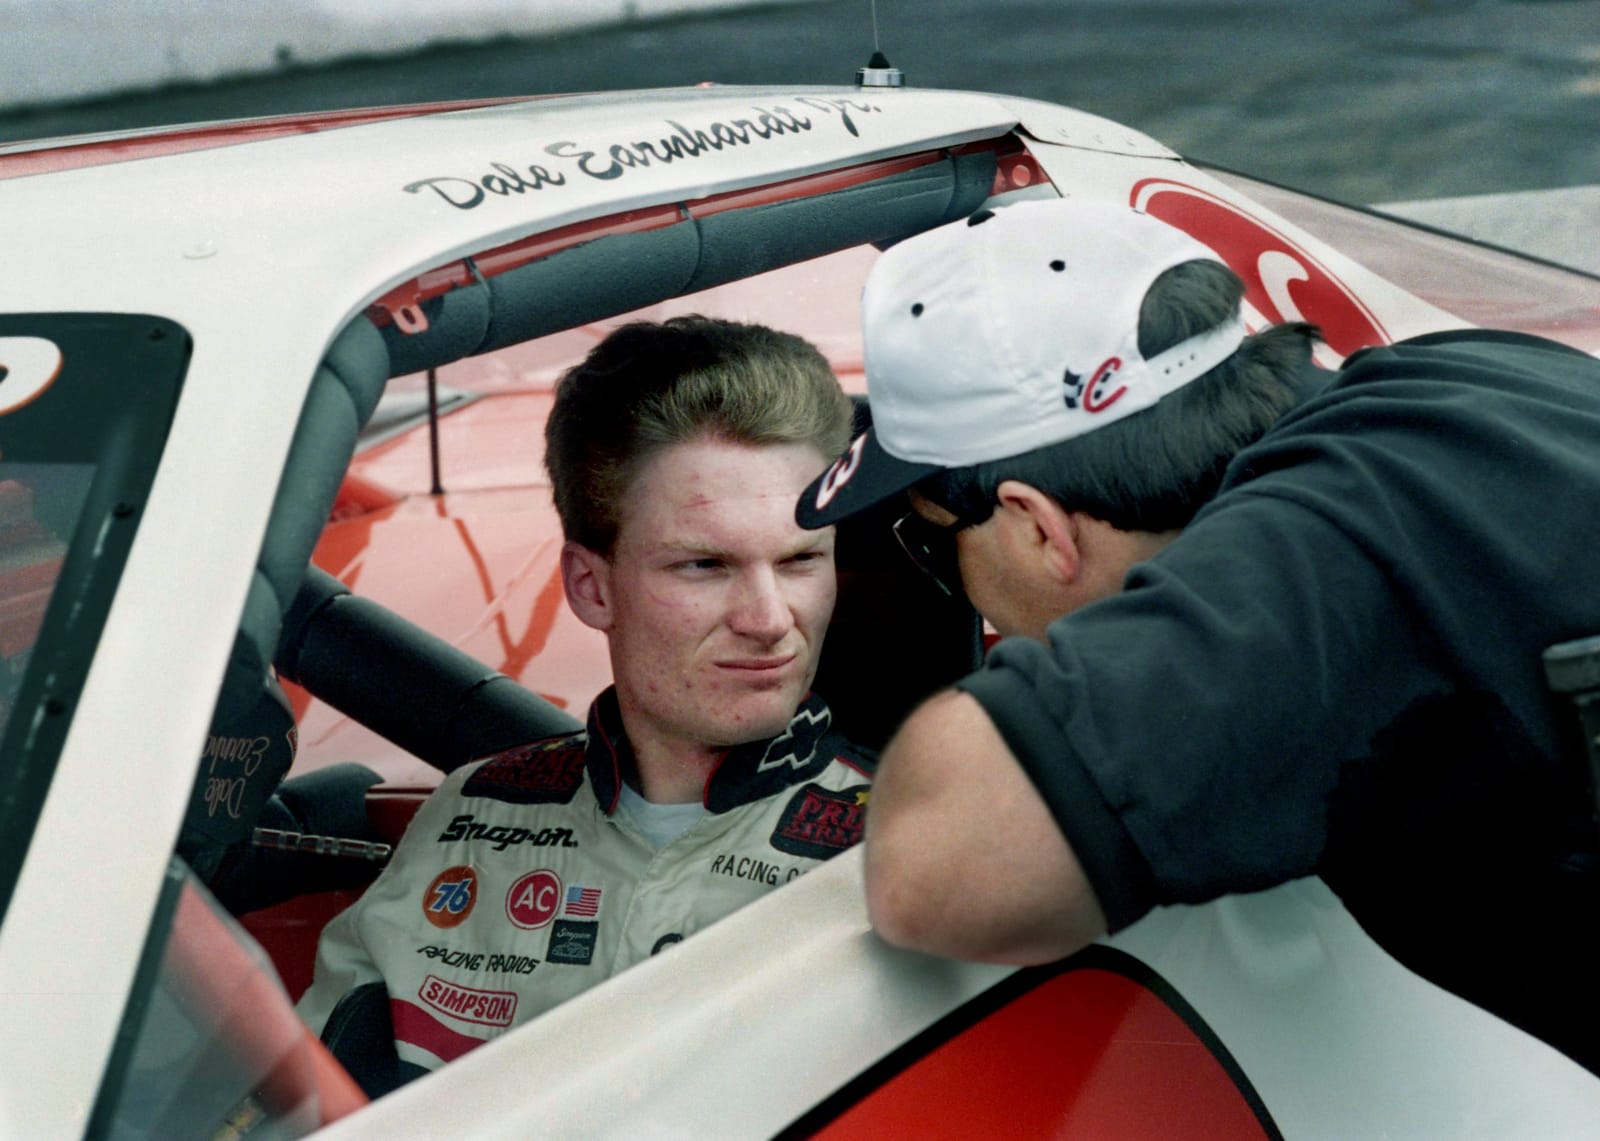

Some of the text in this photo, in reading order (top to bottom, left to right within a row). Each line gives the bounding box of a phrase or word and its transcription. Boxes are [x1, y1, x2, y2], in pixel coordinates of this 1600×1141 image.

[402, 96, 882, 210] Dale Earnhardt Jr.
[815, 432, 868, 510] 3
[204, 777, 246, 819] Dale
[711, 855, 780, 885] RACING
[430, 878, 471, 913] 76
[514, 884, 554, 912] AC
[416, 946, 541, 975] RACING RADIOS
[426, 982, 512, 1020] SIMPSON
